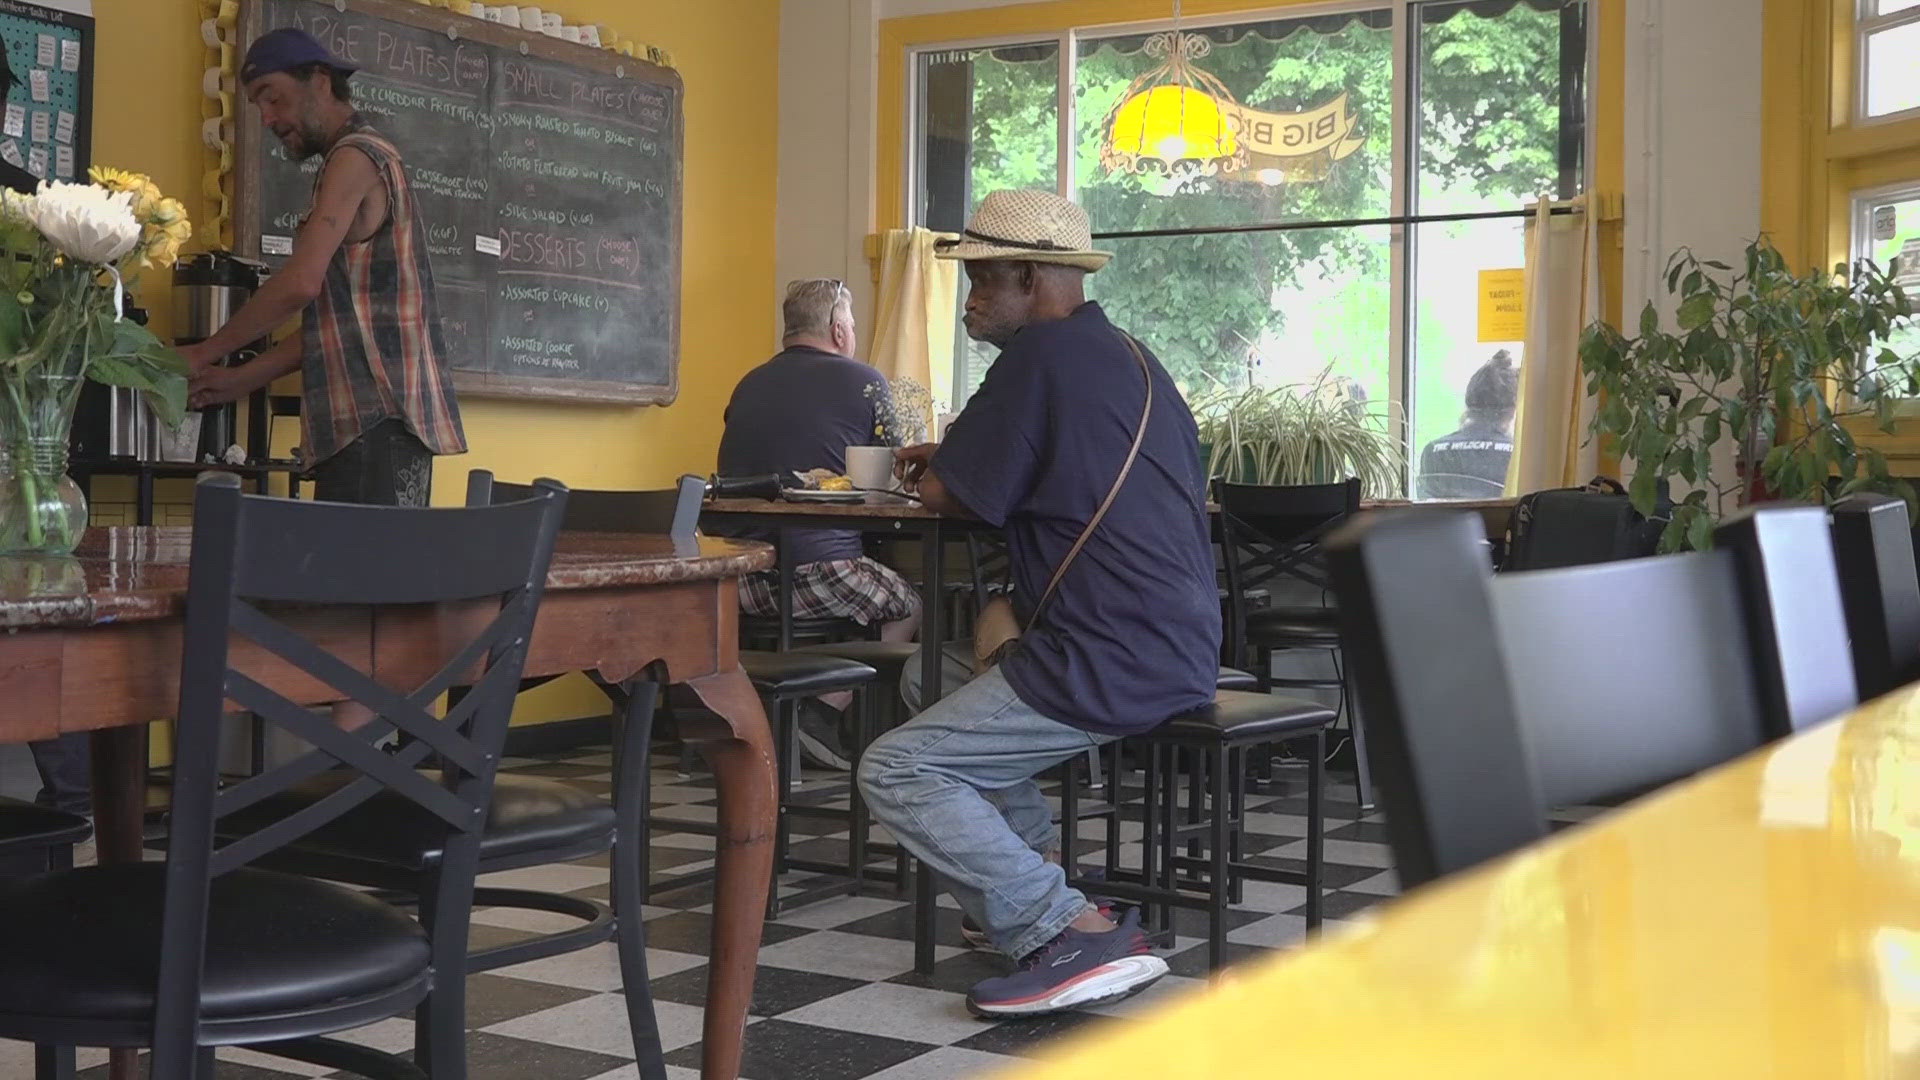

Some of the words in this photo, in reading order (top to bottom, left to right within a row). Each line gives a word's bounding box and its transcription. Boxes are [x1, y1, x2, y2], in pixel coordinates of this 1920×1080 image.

[377, 31, 451, 82] PLATES
[504, 63, 563, 100] SMALL
[571, 80, 625, 109] PLATES
[377, 88, 426, 109] CHEDDAR
[503, 113, 533, 130] SMOKY
[535, 114, 570, 133] ROASTED
[502, 151, 531, 170] POTATO
[602, 171, 623, 188] FRUIT
[506, 203, 528, 220] SIDE
[532, 209, 566, 224] SALAD
[499, 228, 586, 269] DESSERTS
[506, 285, 549, 302] ASSORTED
[553, 288, 591, 309] CUPCAKE
[505, 336, 543, 352] ASSORTED
[546, 341, 575, 355] COOKIE
